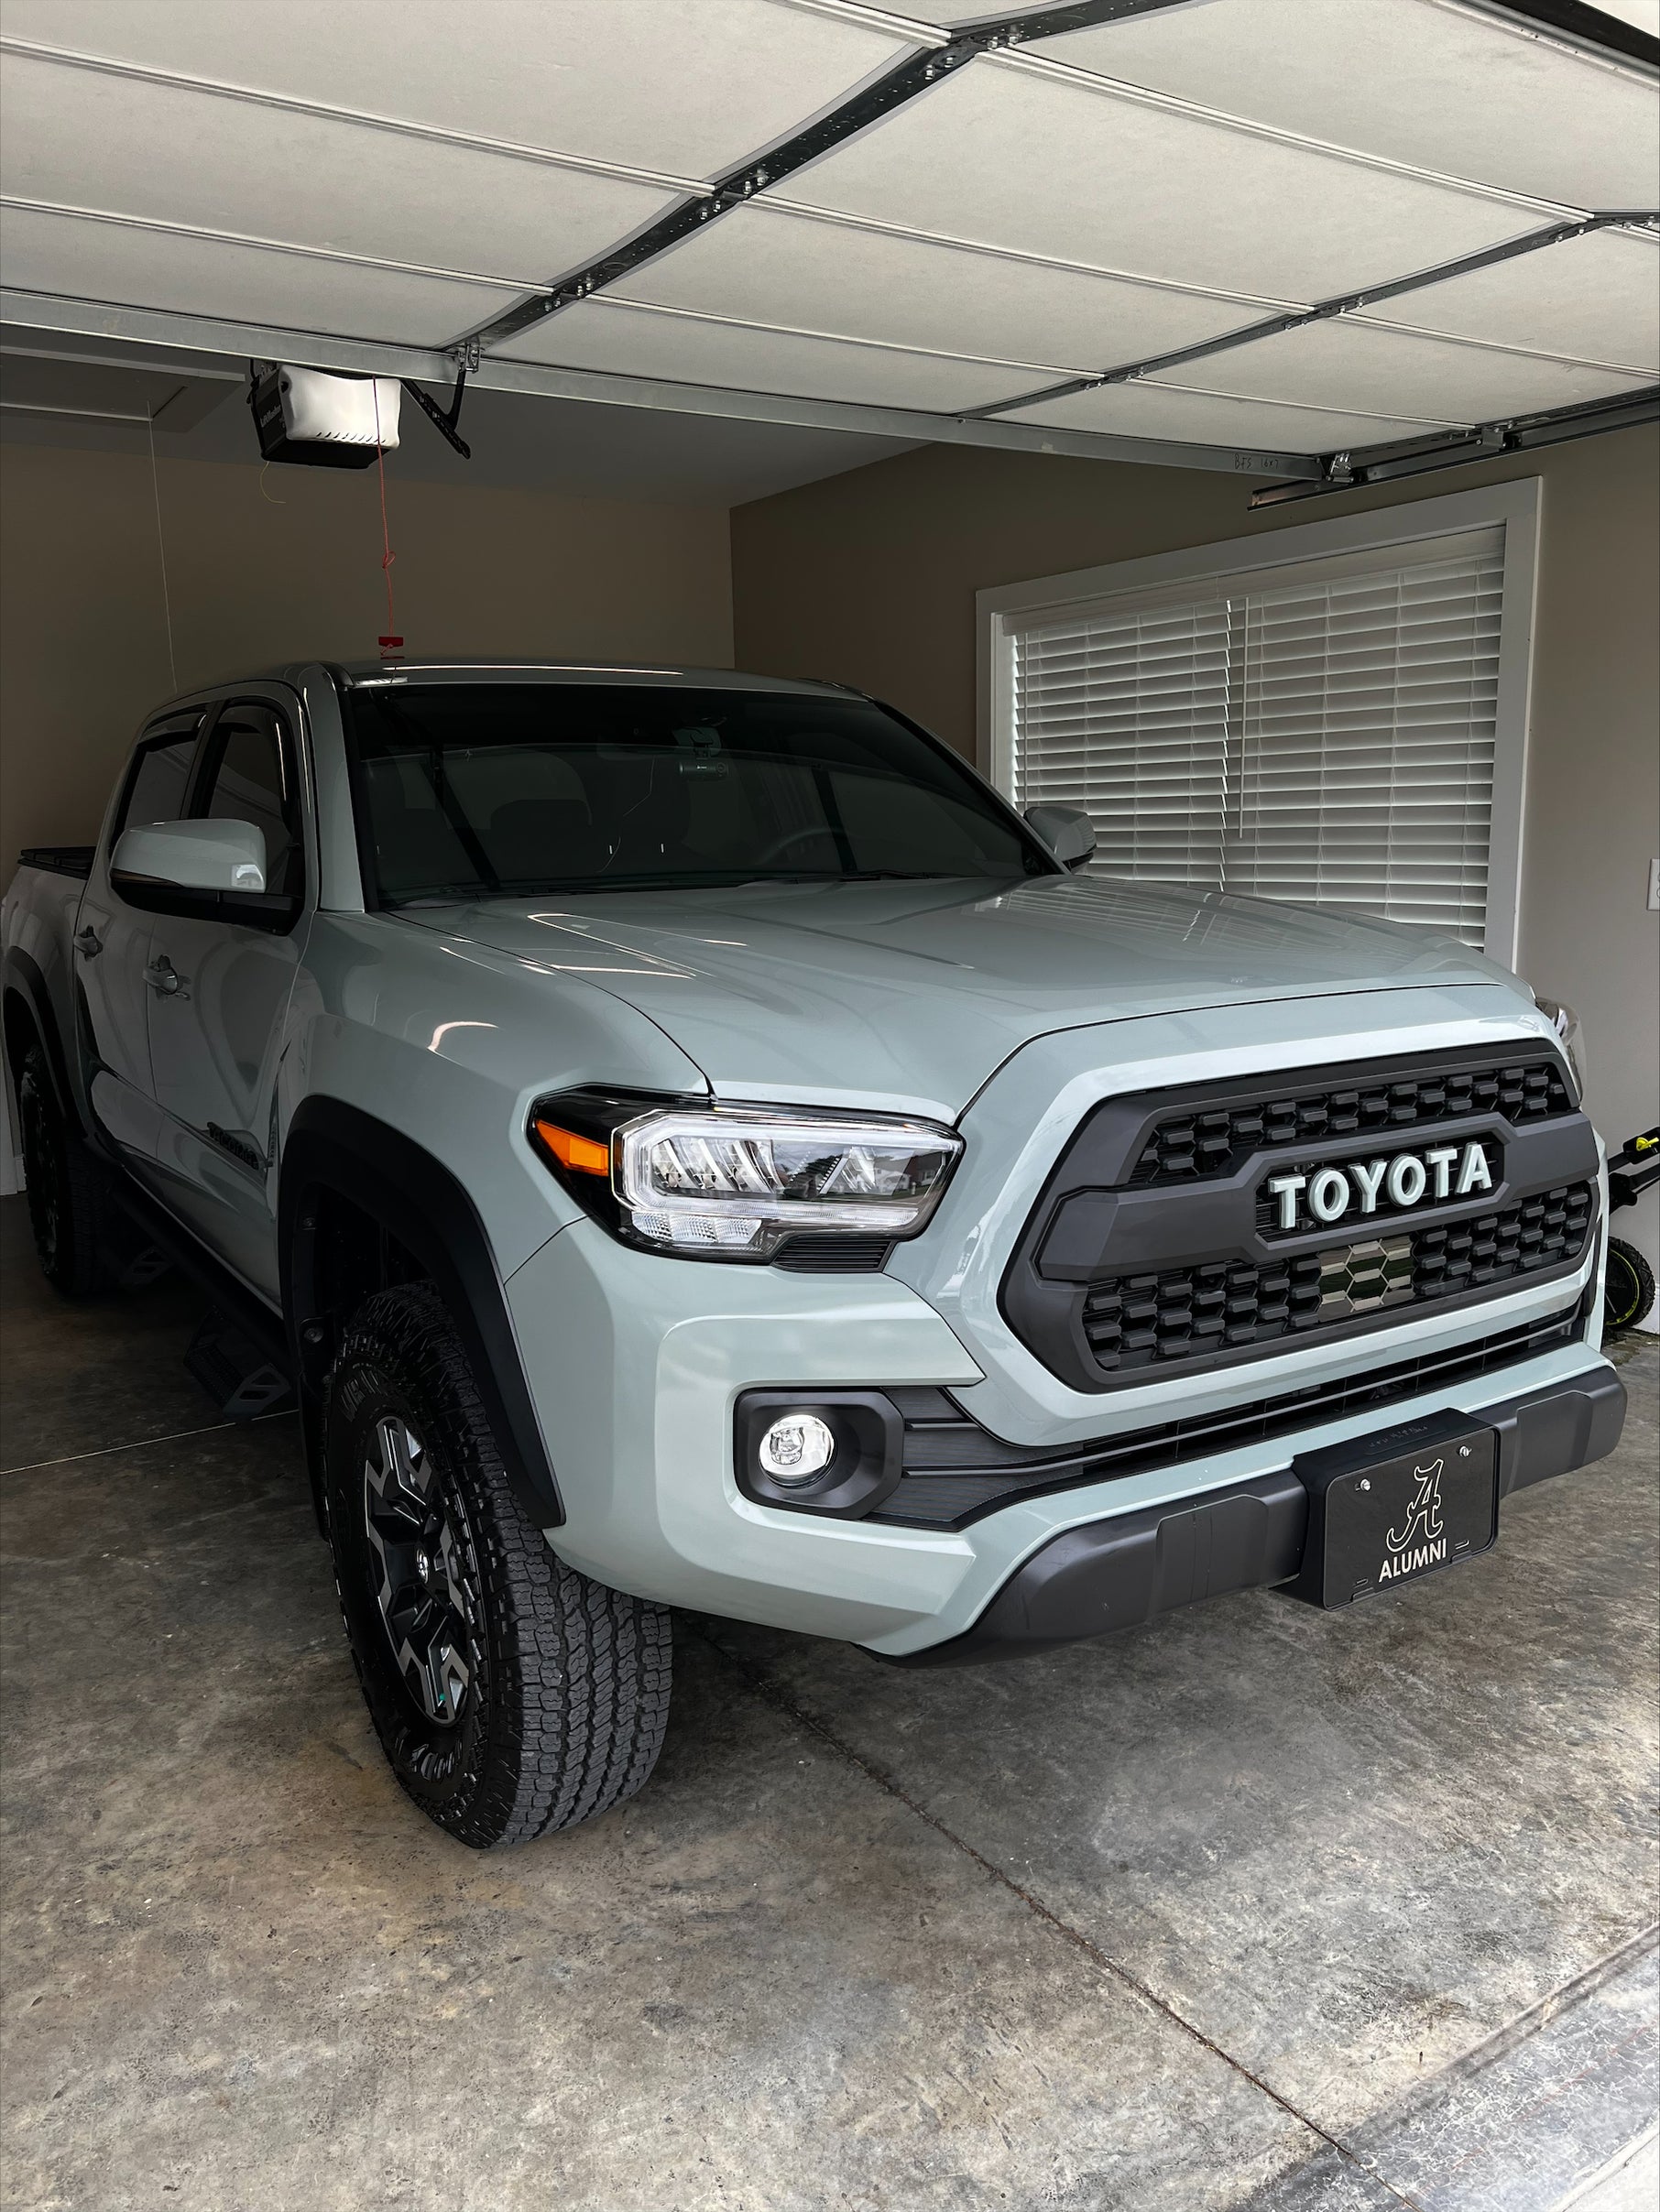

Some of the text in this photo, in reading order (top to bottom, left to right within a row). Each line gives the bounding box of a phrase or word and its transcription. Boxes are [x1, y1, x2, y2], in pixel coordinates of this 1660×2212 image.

[1269, 1142, 1492, 1229] TOYOTA
[1386, 1458, 1444, 1553] A
[1378, 1538, 1447, 1583] ALUMNI
